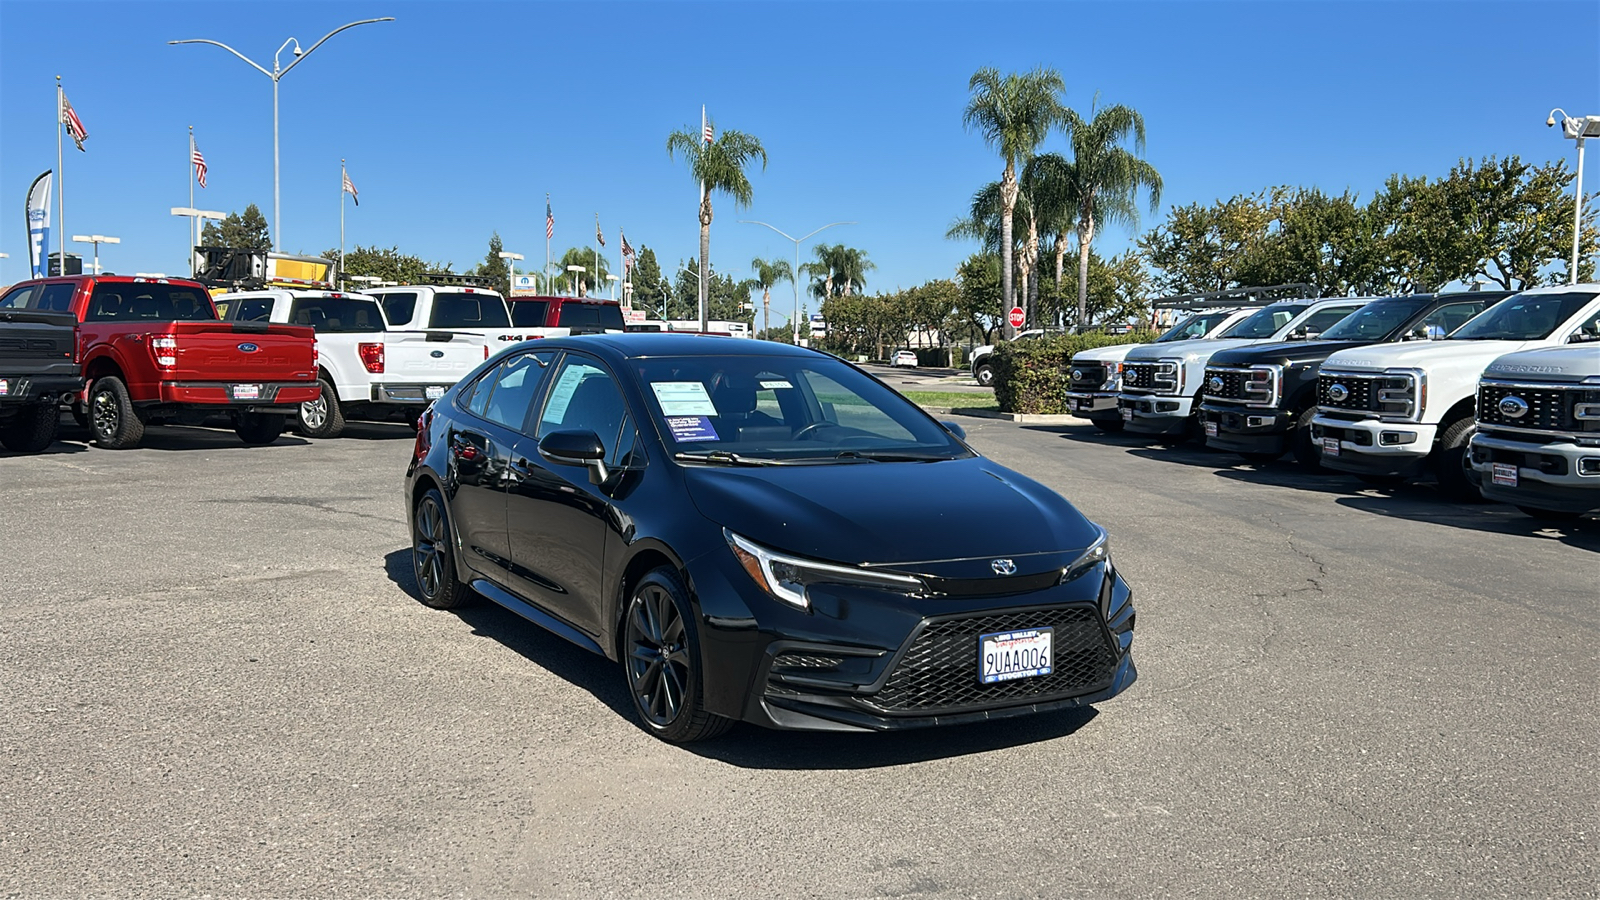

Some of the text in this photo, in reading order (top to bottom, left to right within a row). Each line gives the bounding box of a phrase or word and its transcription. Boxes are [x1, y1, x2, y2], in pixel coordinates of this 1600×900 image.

[1010, 313, 1024, 322] STOP
[1491, 364, 1563, 373] SUPER DUTY
[986, 646, 1047, 674] 9UAA006
[997, 669, 1038, 680] STOCKTON
